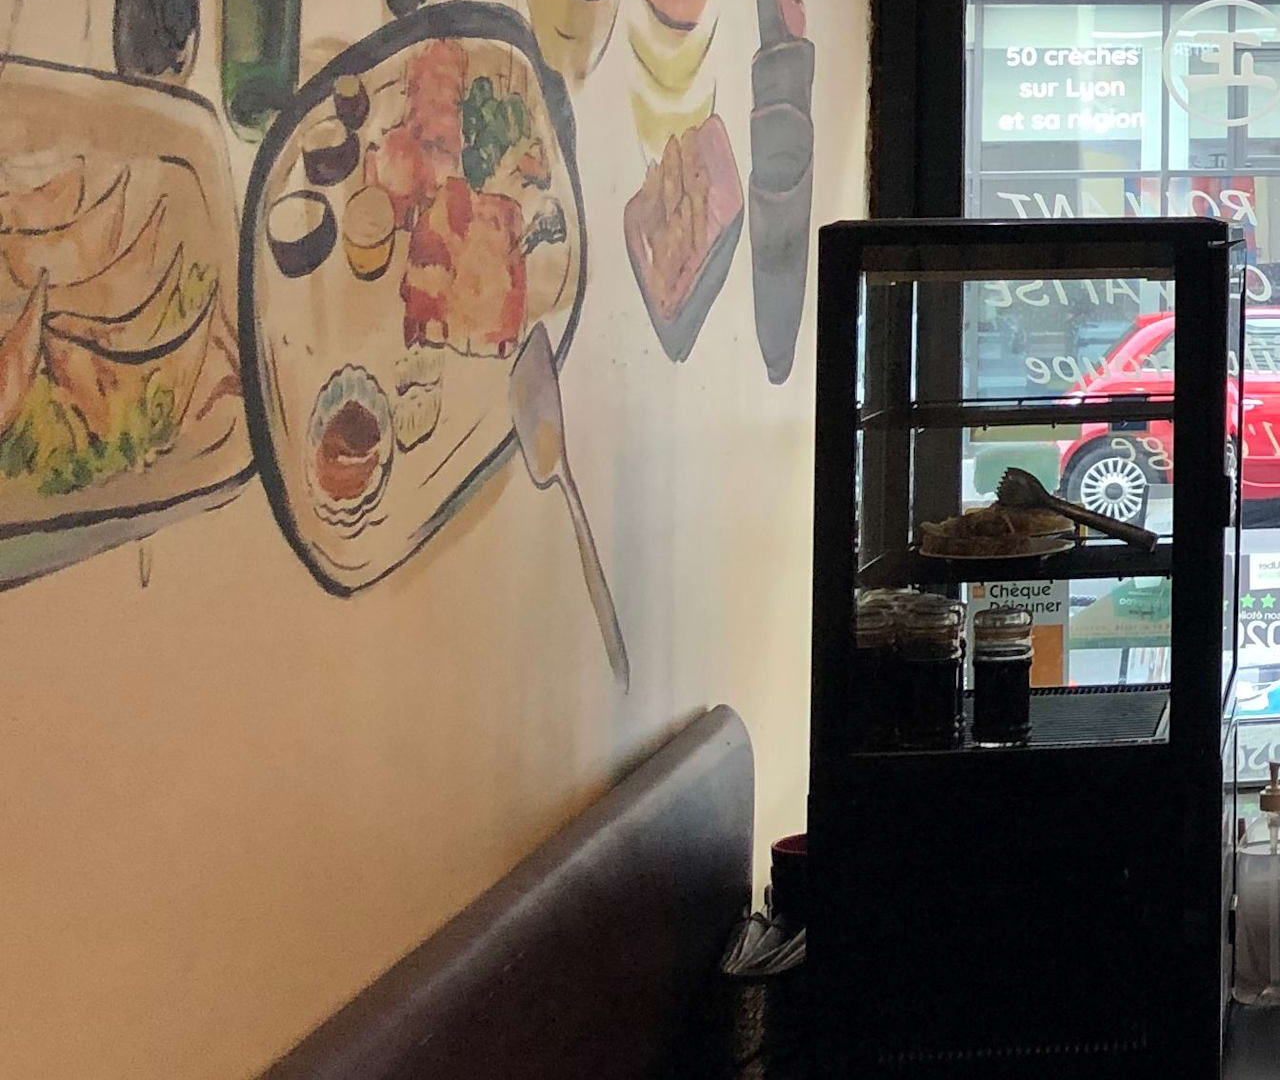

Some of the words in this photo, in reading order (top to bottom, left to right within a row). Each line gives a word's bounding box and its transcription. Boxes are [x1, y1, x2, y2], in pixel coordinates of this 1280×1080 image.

[1006, 46, 1038, 67] 50
[1044, 46, 1140, 67] crèches
[1018, 81, 1059, 98] sur
[1066, 78, 1126, 103] Lyon
[998, 111, 1025, 131] et
[1030, 113, 1061, 131] sa
[1067, 107, 1145, 134] région
[989, 583, 1052, 603] Chèque
